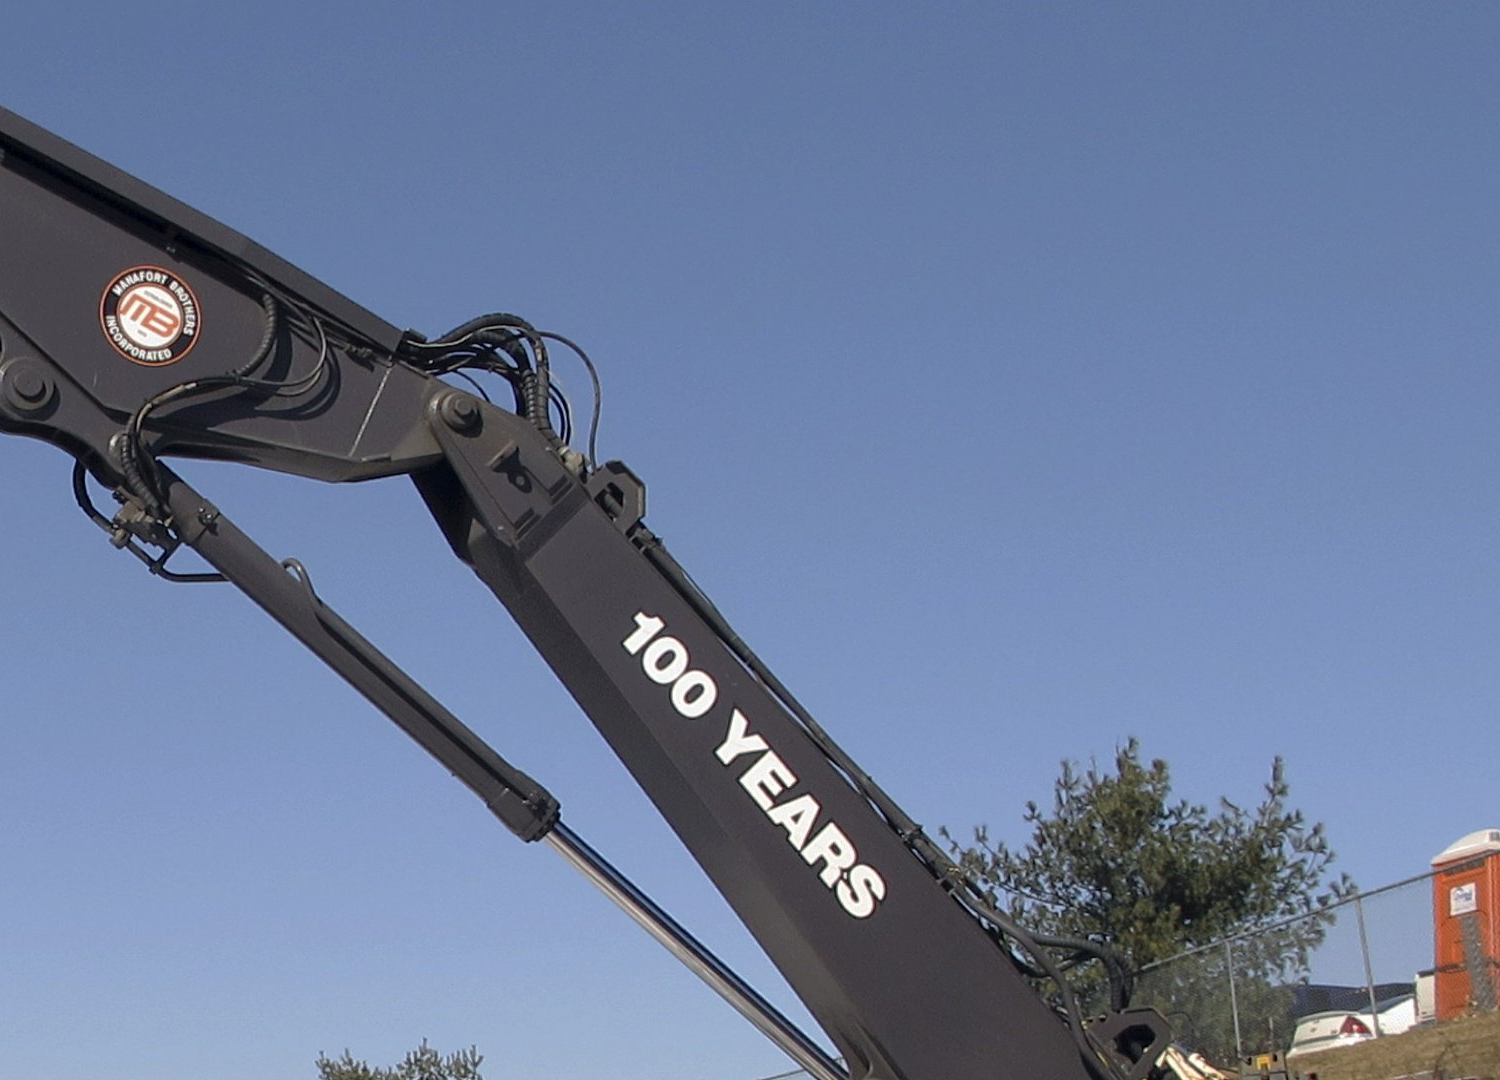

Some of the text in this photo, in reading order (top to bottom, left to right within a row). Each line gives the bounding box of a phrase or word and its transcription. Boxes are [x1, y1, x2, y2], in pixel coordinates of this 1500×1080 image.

[112, 270, 169, 297] MANAFORT
[169, 280, 197, 337] BROTHERS
[105, 315, 172, 361] INCORPORATED
[621, 610, 888, 919] 100 YEARS
